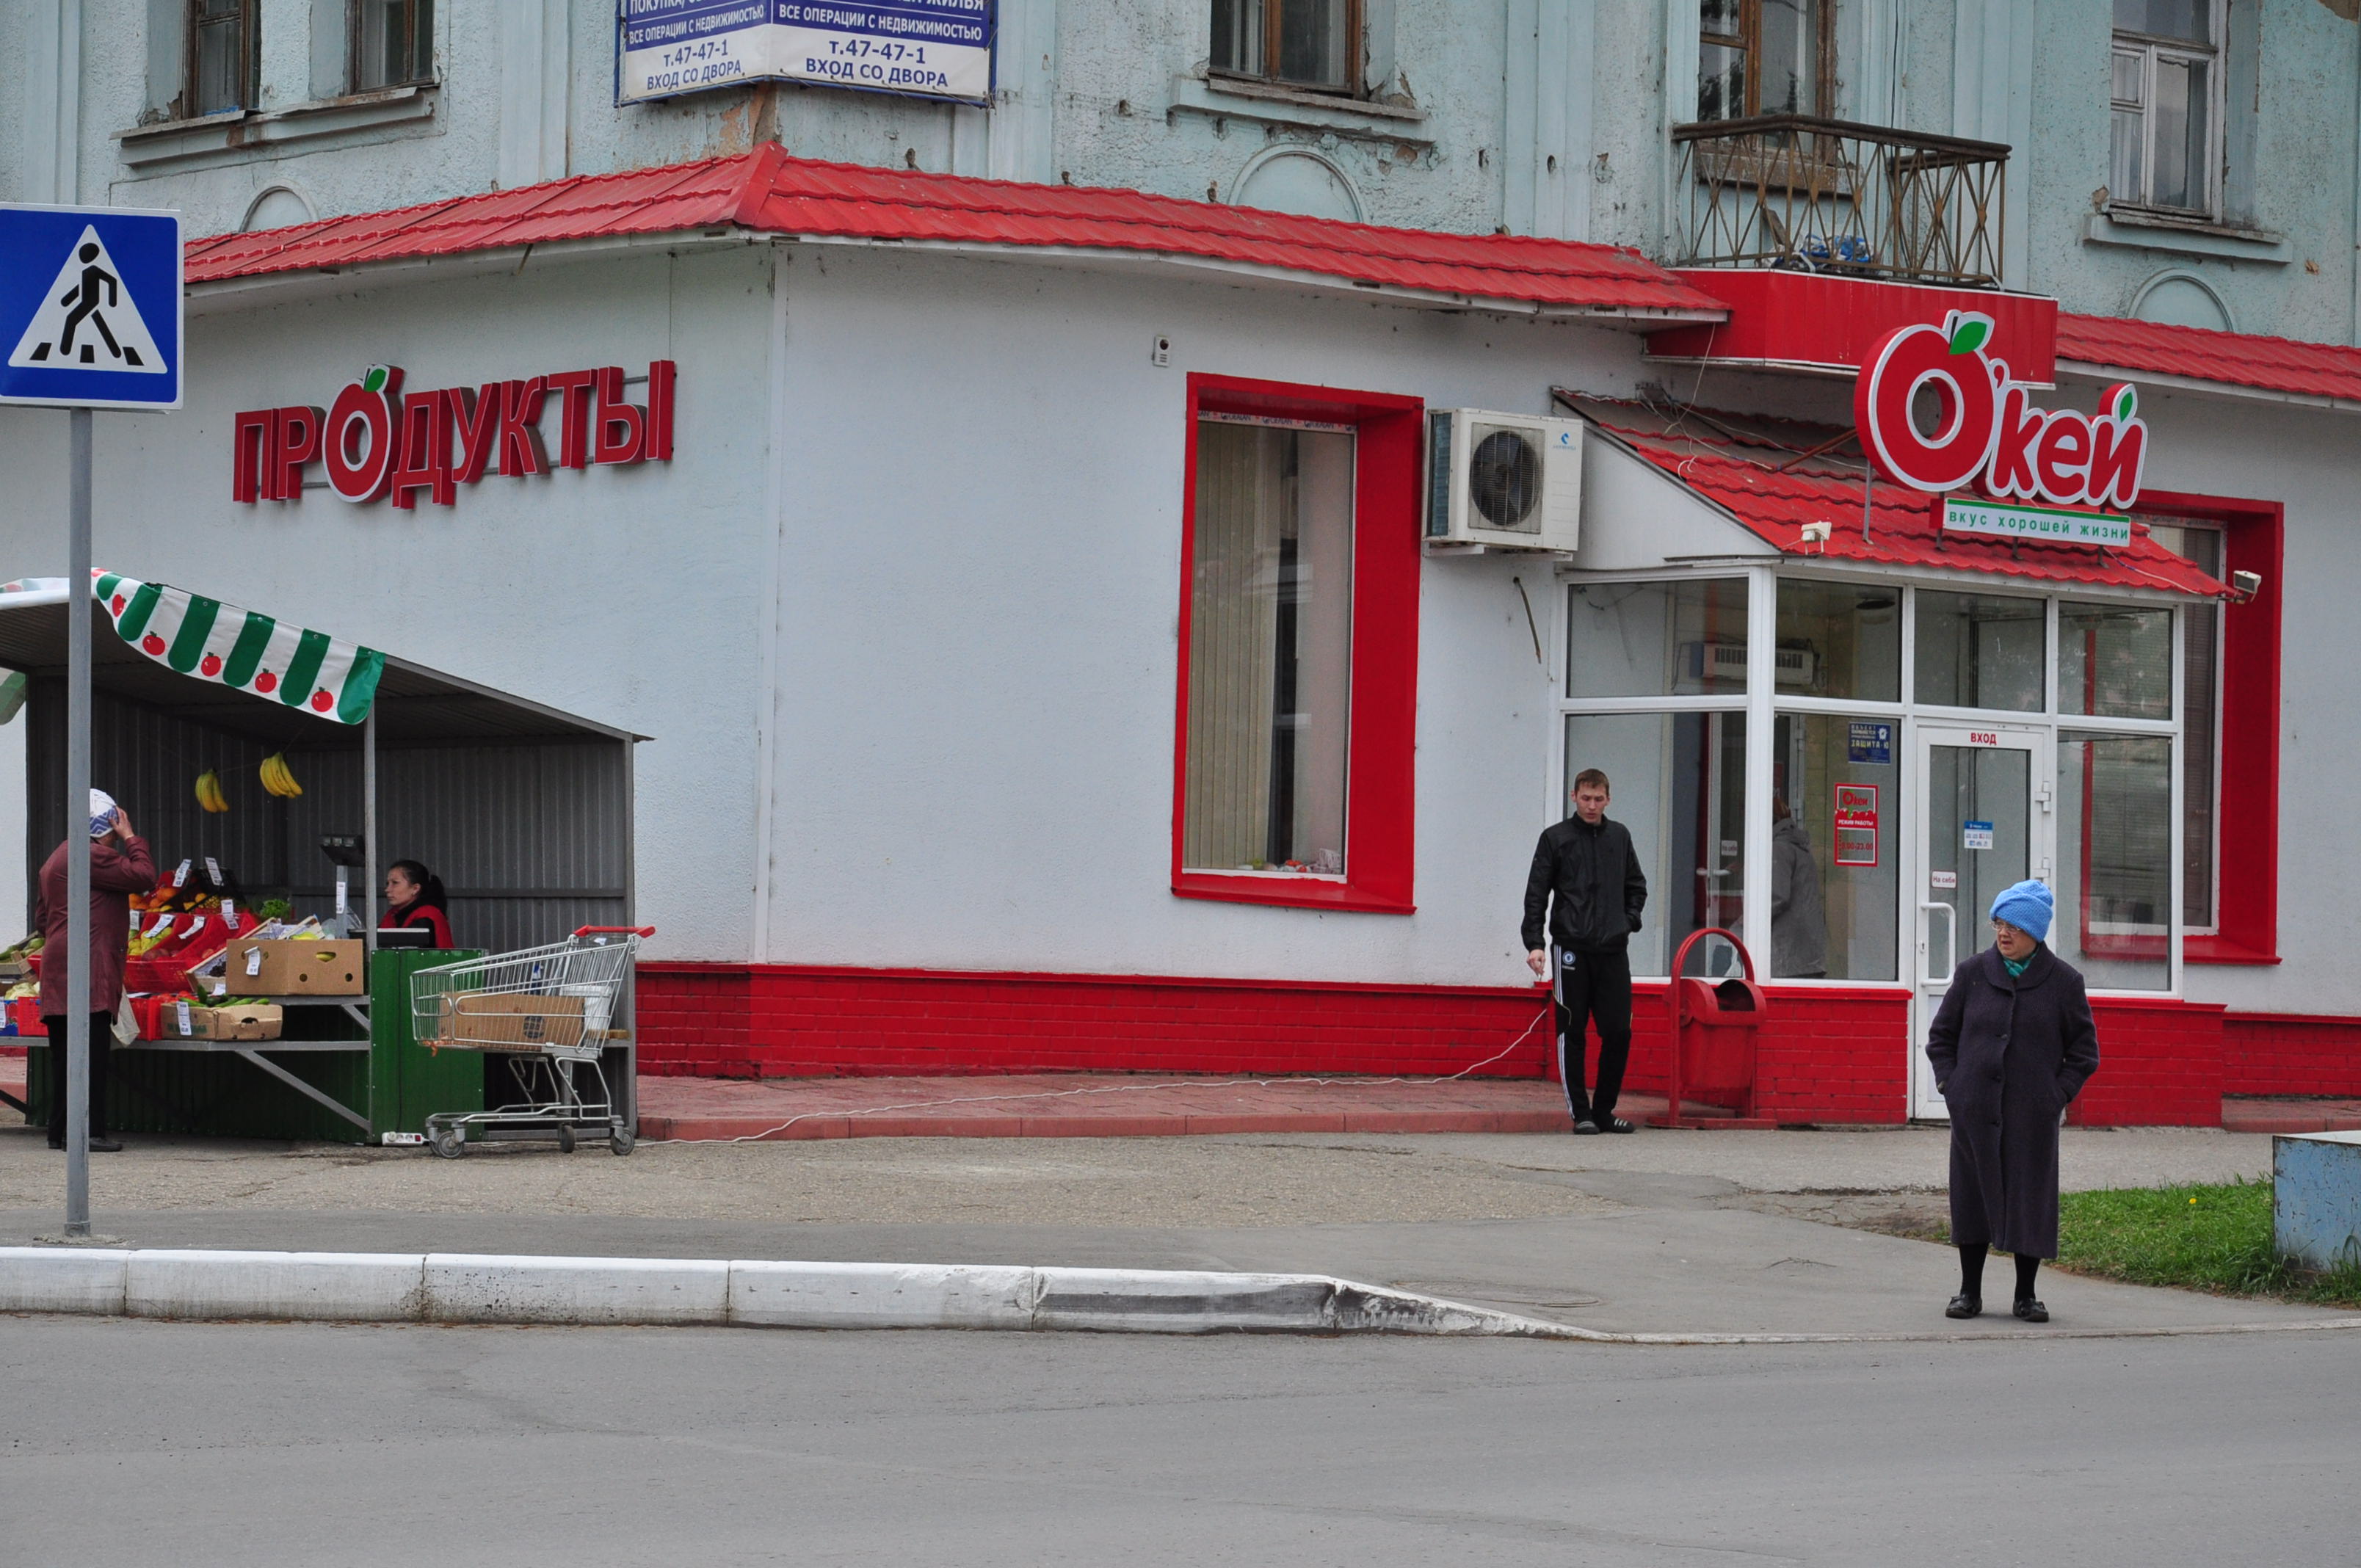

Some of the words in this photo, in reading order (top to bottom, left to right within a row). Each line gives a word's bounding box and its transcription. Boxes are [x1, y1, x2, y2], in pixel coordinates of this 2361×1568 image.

[629, 29, 644, 45] ВСЕ
[645, 23, 687, 40] ОПЕРАЦИИ
[689, 23, 694, 33] С
[695, 4, 764, 32] НЕДВИЖИМОСТЬЮ
[779, 4, 800, 20] ВСЕ
[803, 7, 866, 28] ОПЕРАЦИИ
[868, 15, 875, 23] С
[878, 15, 982, 41] НЕДВИЖИМОСТЬЮ
[664, 39, 728, 67] т.47-47-1
[829, 39, 926, 65] т.47-47-1
[647, 71, 679, 90] ВХОД
[683, 68, 697, 84] СО
[701, 59, 741, 83] ДВОРА
[805, 58, 854, 79] ВХОД
[860, 64, 883, 79] СО
[888, 68, 949, 87] ДВОРА
[233, 360, 675, 509] ПРОДУКТЫ
[1949, 511, 1987, 527] вкус
[1998, 517, 2070, 534] хорошей
[2080, 524, 2128, 540] жизни
[1970, 733, 1997, 746] ВХОД
